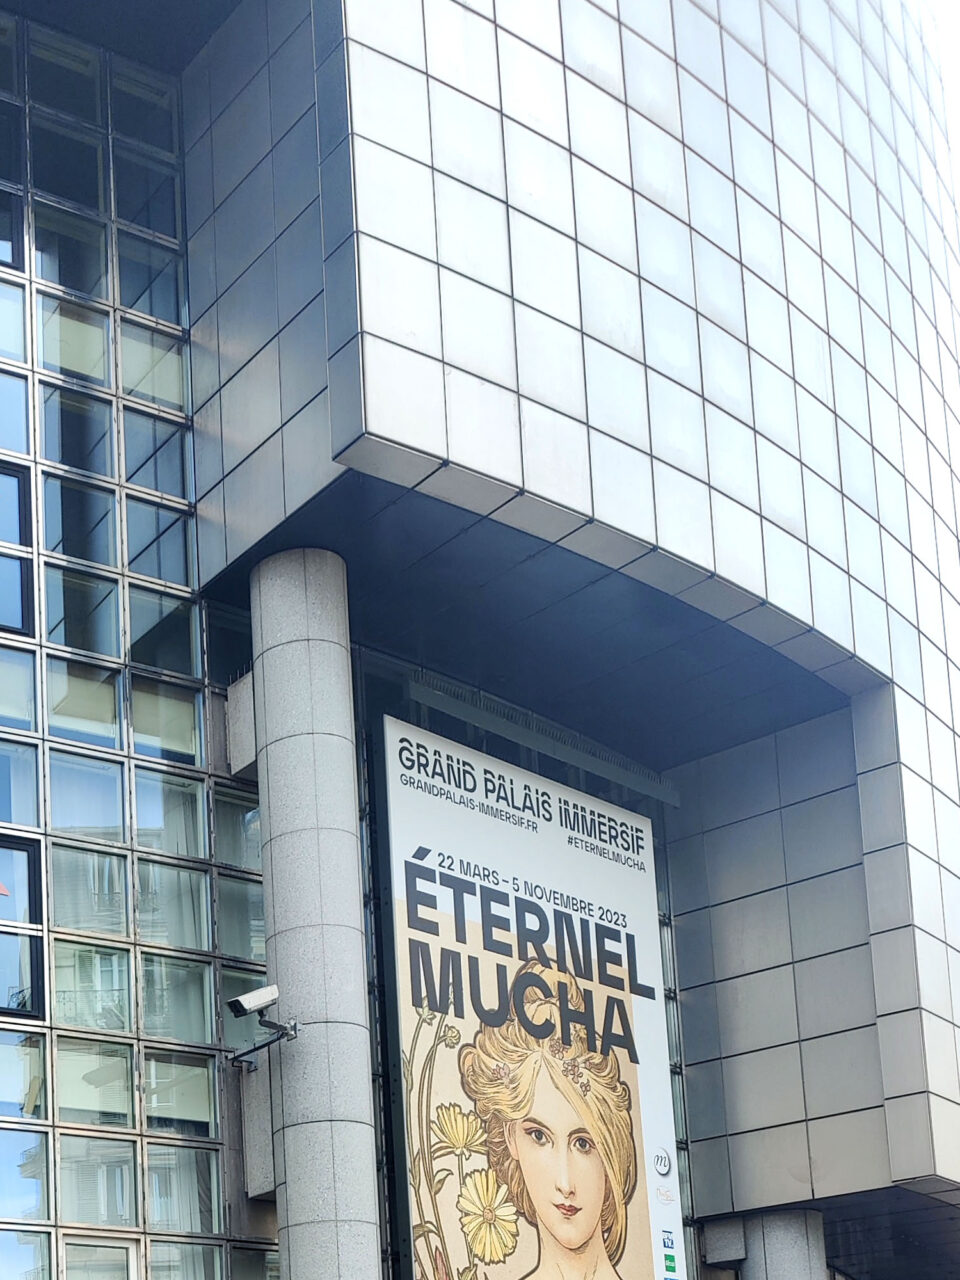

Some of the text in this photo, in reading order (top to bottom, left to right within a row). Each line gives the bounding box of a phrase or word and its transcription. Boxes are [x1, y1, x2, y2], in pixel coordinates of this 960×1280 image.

[398, 737, 645, 856] GRAND PALAIS IMMERSIF
[400, 774, 539, 834] GRANDPALAIS-IMMERSIF.FR
[437, 852, 455, 871] 22
[459, 859, 500, 886] MARS
[513, 877, 521, 893] 5
[524, 881, 595, 918] NOVEMBRE
[598, 906, 628, 929] 2023
[567, 835, 646, 873] #ETERNELMUCHA
[404, 845, 656, 1000] ÉTERNEL
[408, 938, 640, 1065] MUCHA
